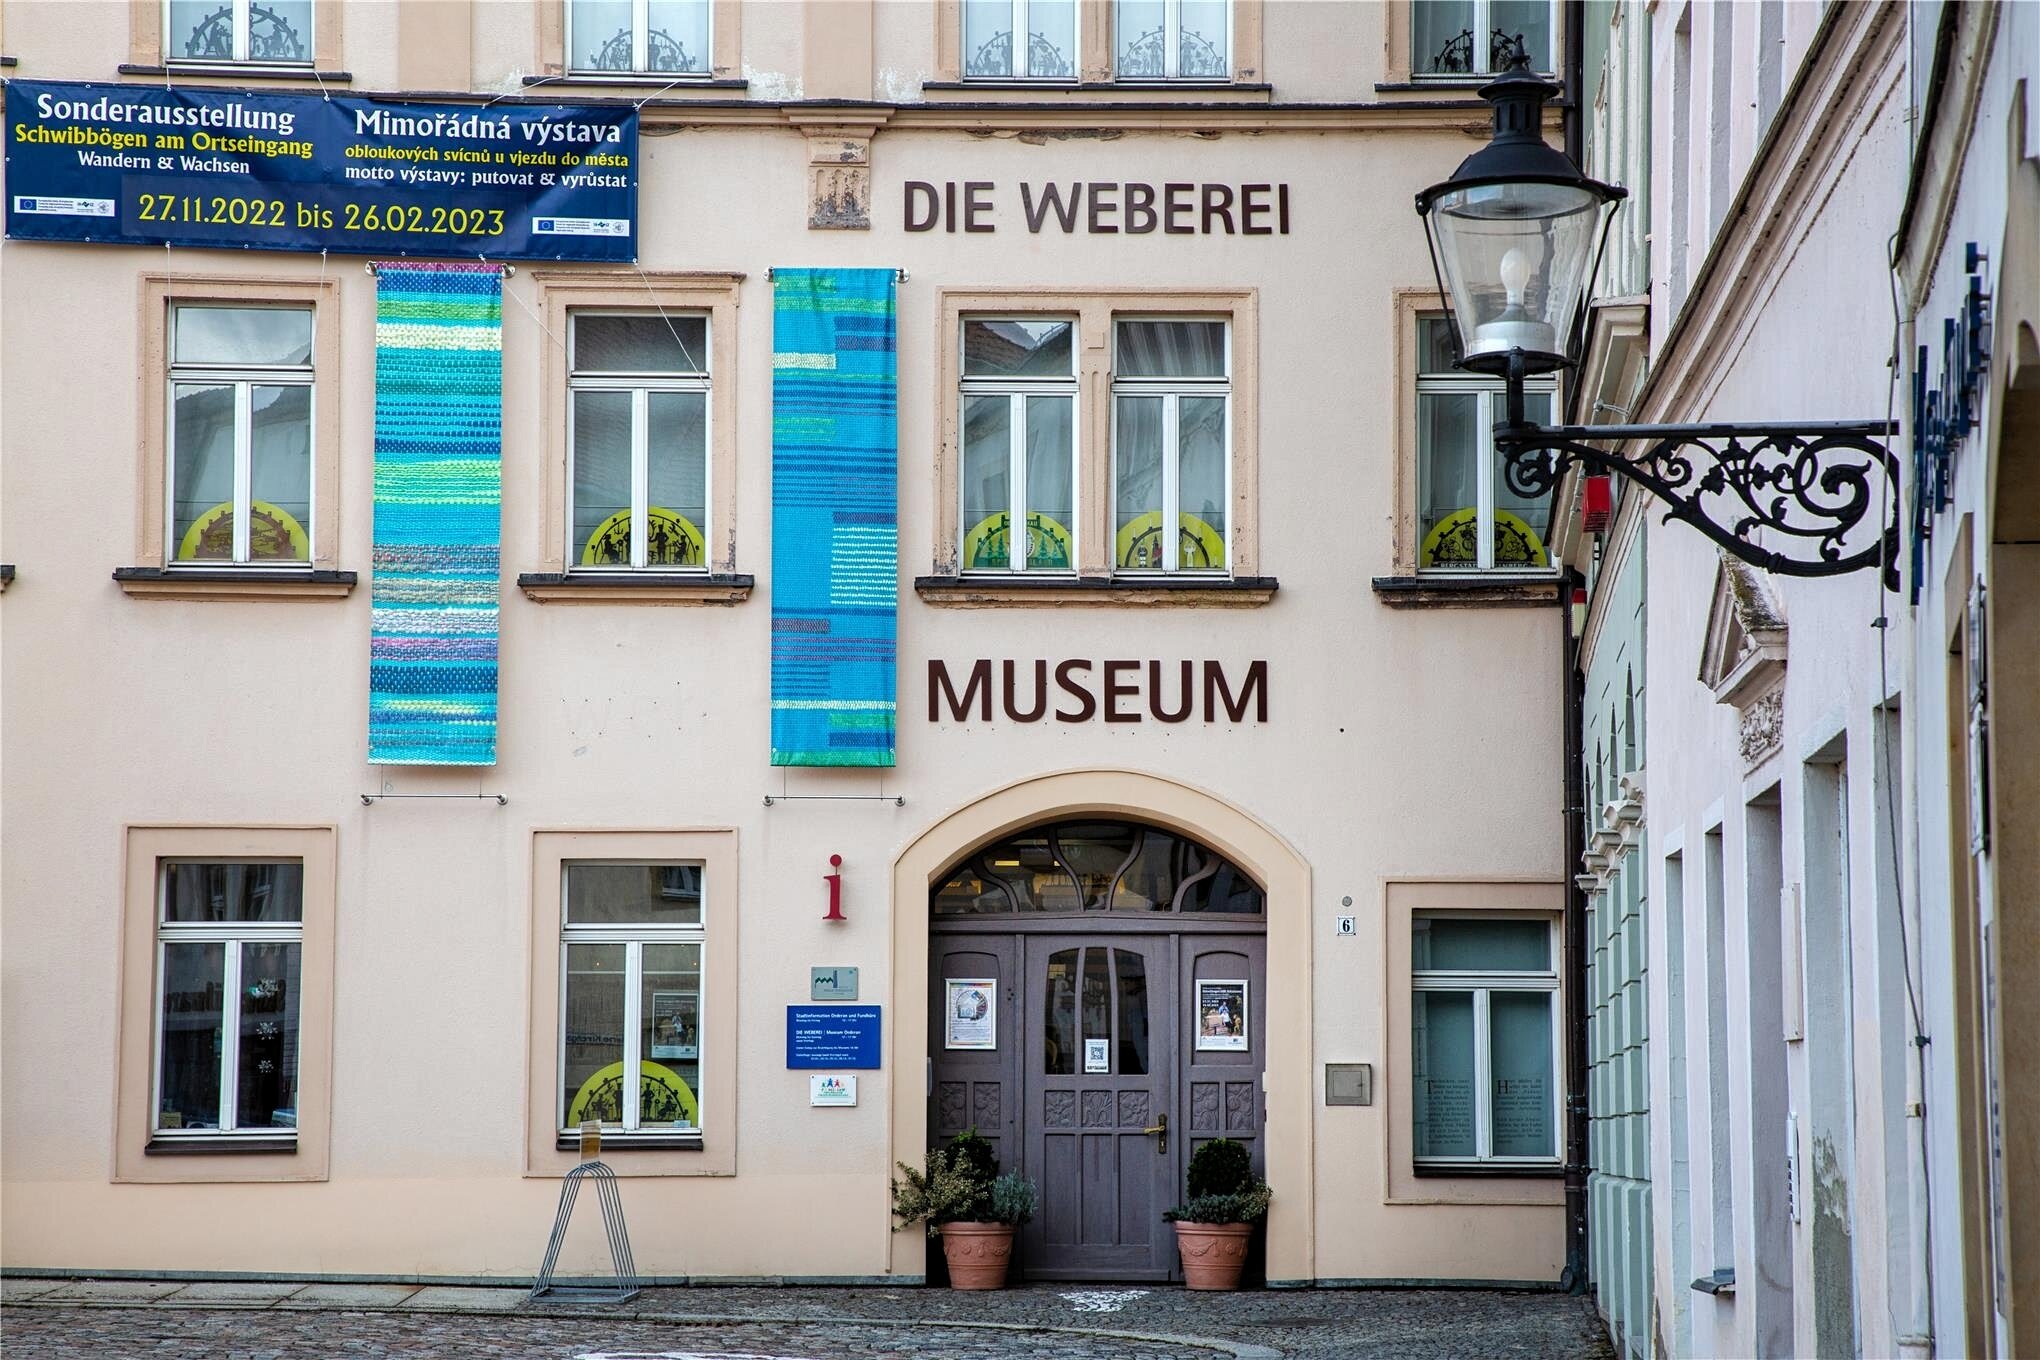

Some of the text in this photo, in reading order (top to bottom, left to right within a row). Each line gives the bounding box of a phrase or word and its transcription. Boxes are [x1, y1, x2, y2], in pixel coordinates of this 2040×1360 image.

[37, 93, 295, 135] Sonderausstellung
[355, 109, 621, 146] Mimořádná výstava
[16, 123, 313, 159] Schwibbögen am Ortseingang
[345, 144, 628, 167] obloukových svícnů u vjezdu do města
[77, 150, 250, 174] Wandern & Wachsen
[345, 166, 627, 188] motto výstavy: putovat & vyrůstat
[139, 194, 505, 236] 27.11.2022 bis 26.02.2023
[904, 181, 1290, 235] DIE WEBEREI
[928, 658, 1268, 724] MUSEUM
[822, 854, 847, 920] i
[1342, 919, 1351, 933] 6
